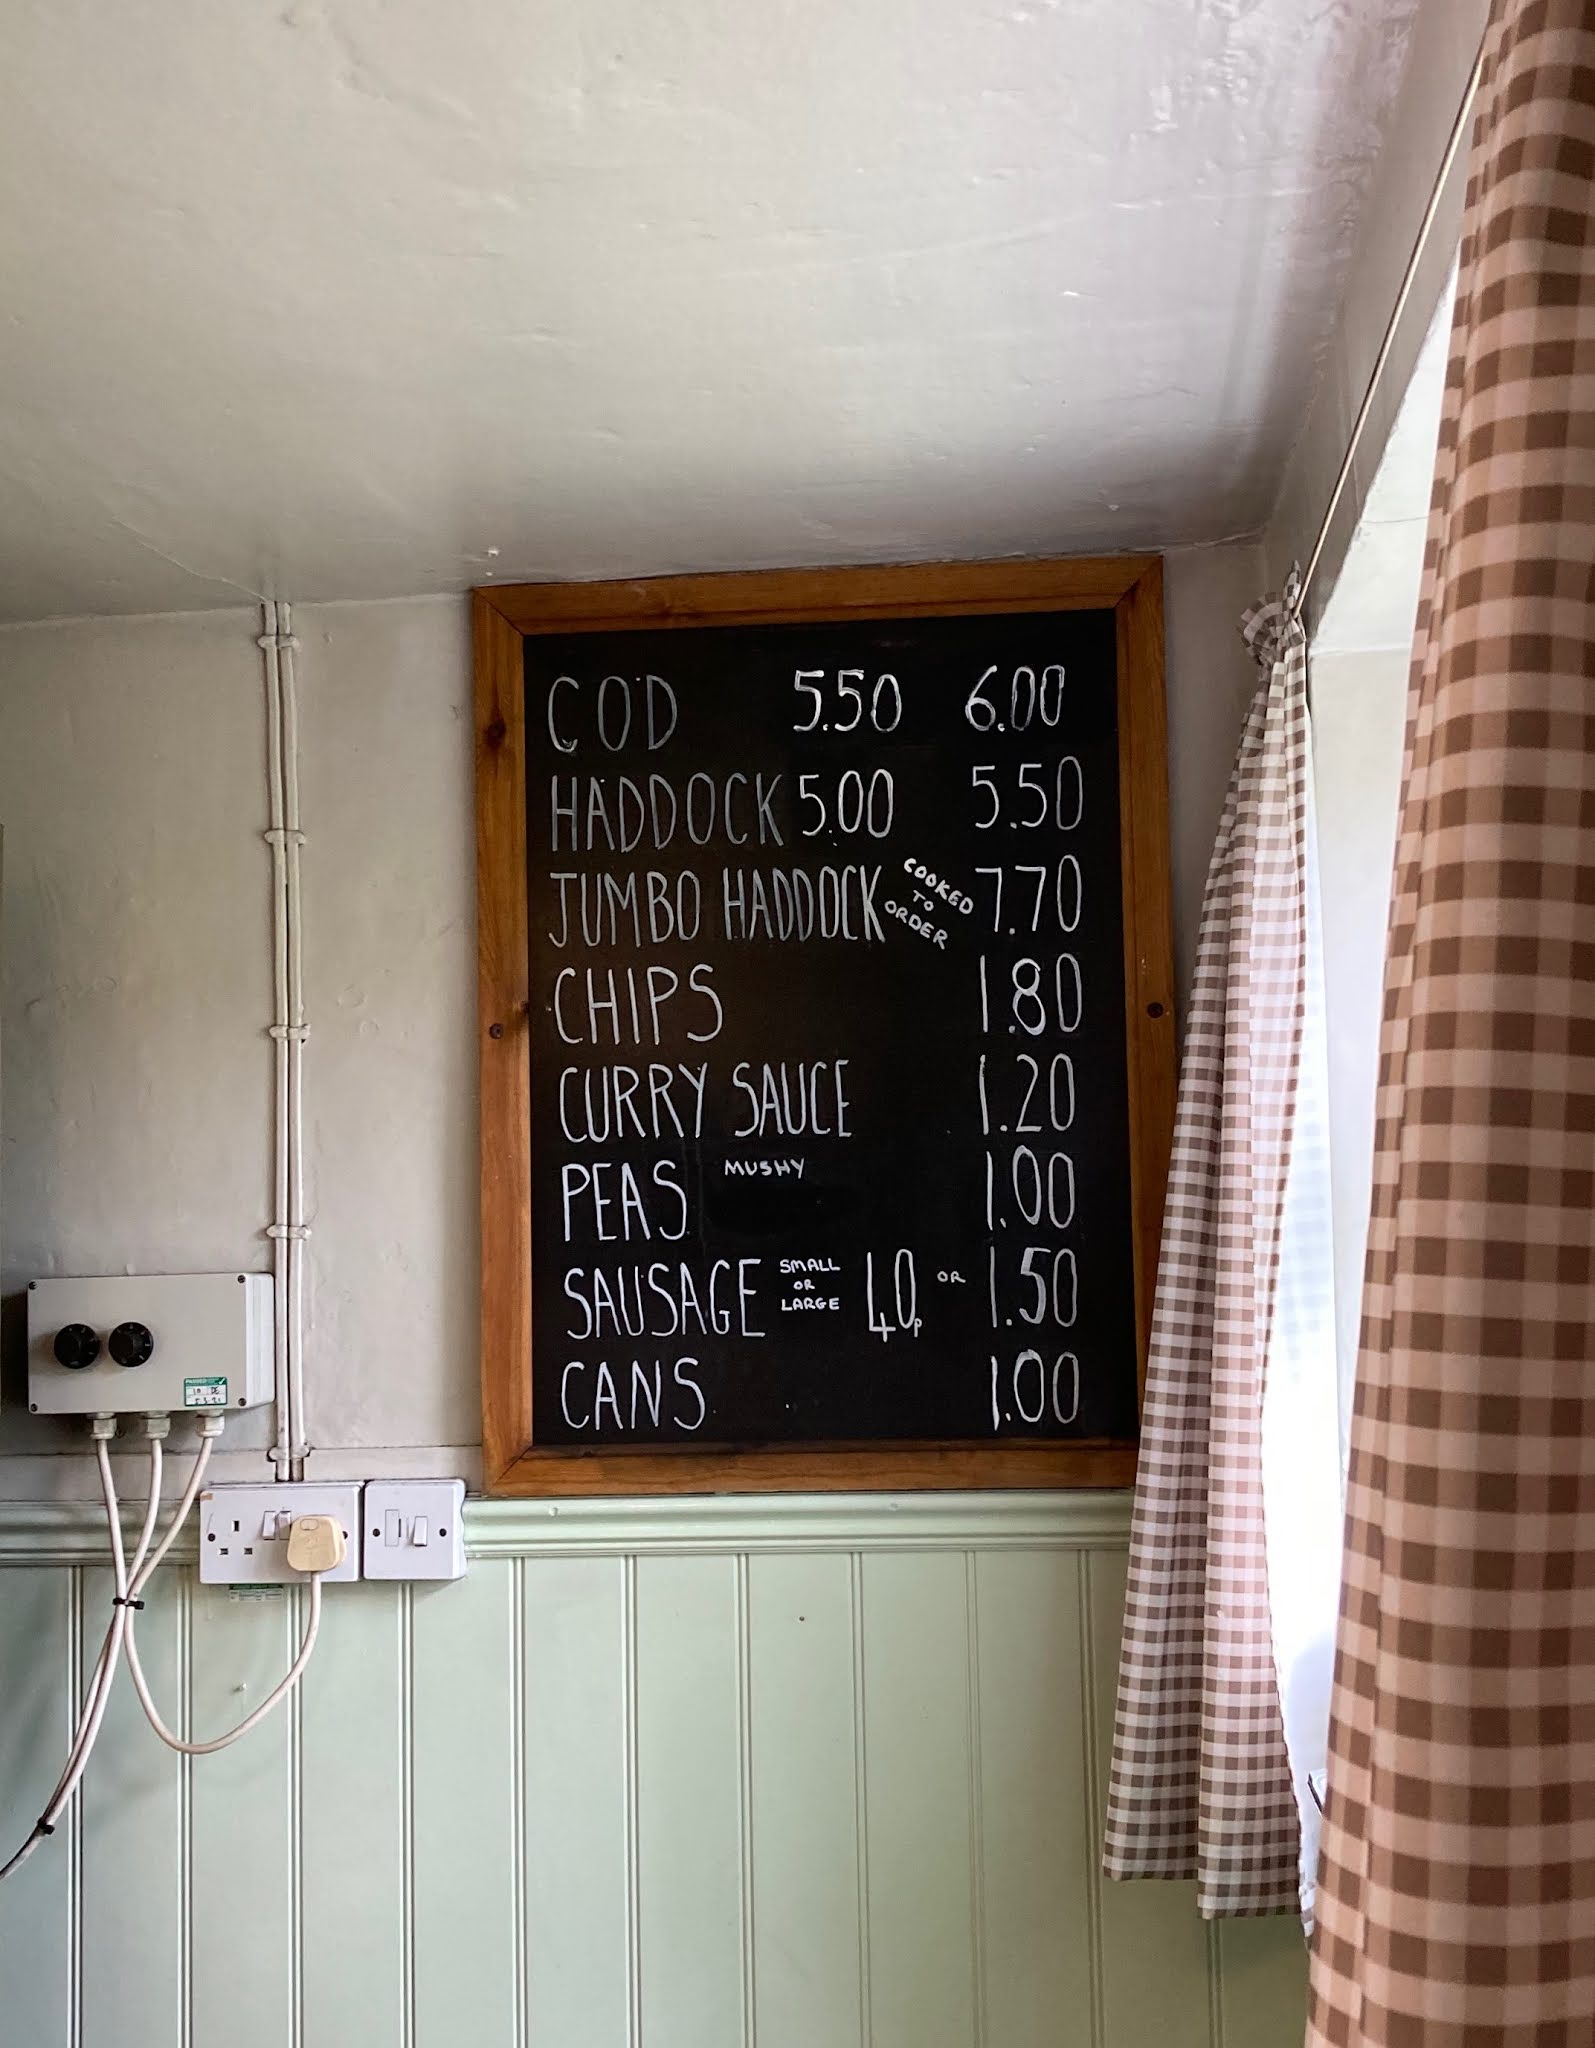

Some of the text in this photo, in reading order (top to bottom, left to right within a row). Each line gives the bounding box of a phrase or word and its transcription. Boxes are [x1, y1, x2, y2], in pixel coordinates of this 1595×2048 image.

[549, 665, 1065, 752] COD 5.50 6.00
[552, 756, 1082, 852] HADDOCK 5.00 5.50
[549, 865, 885, 947] JUMBO HADDOCK
[885, 900, 949, 950] ORDER
[903, 857, 973, 915] COOKED
[913, 890, 934, 911] TO
[975, 855, 1081, 934] 7.70
[555, 953, 1081, 1045] CHIPS 1.80
[560, 1054, 1074, 1142] CURRY SAUCE 1.20
[562, 1160, 686, 1241] PEAS
[725, 1159, 804, 1178] MUSHY
[987, 1145, 1074, 1230] 1.00
[564, 1259, 765, 1339] SAUSAGE
[780, 1258, 840, 1273] SMALL
[781, 1297, 839, 1311] LARGE
[794, 1279, 815, 1290] OR
[937, 1271, 965, 1283] OR
[990, 1247, 1077, 1327] 1.50
[562, 1349, 1079, 1430] CANS 1.00
